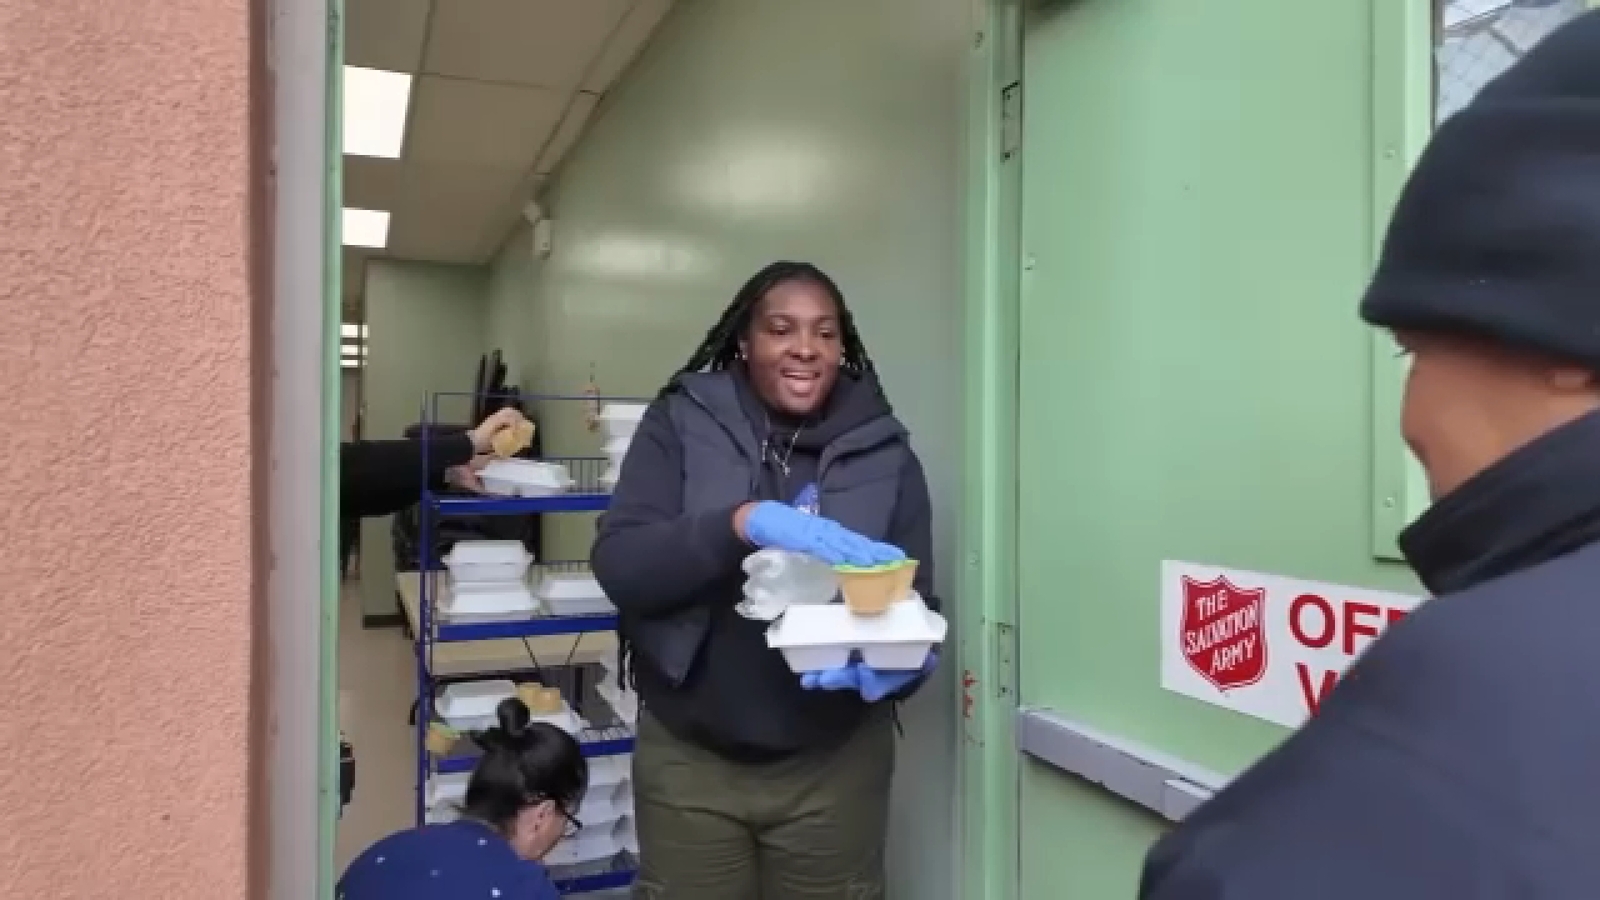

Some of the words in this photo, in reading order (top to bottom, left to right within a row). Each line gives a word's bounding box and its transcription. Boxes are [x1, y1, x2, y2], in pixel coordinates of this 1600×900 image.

[1186, 600, 1258, 655] SALVATION
[1195, 590, 1228, 621] THE
[1289, 593, 1409, 656] OF
[1210, 633, 1256, 675] ARMY
